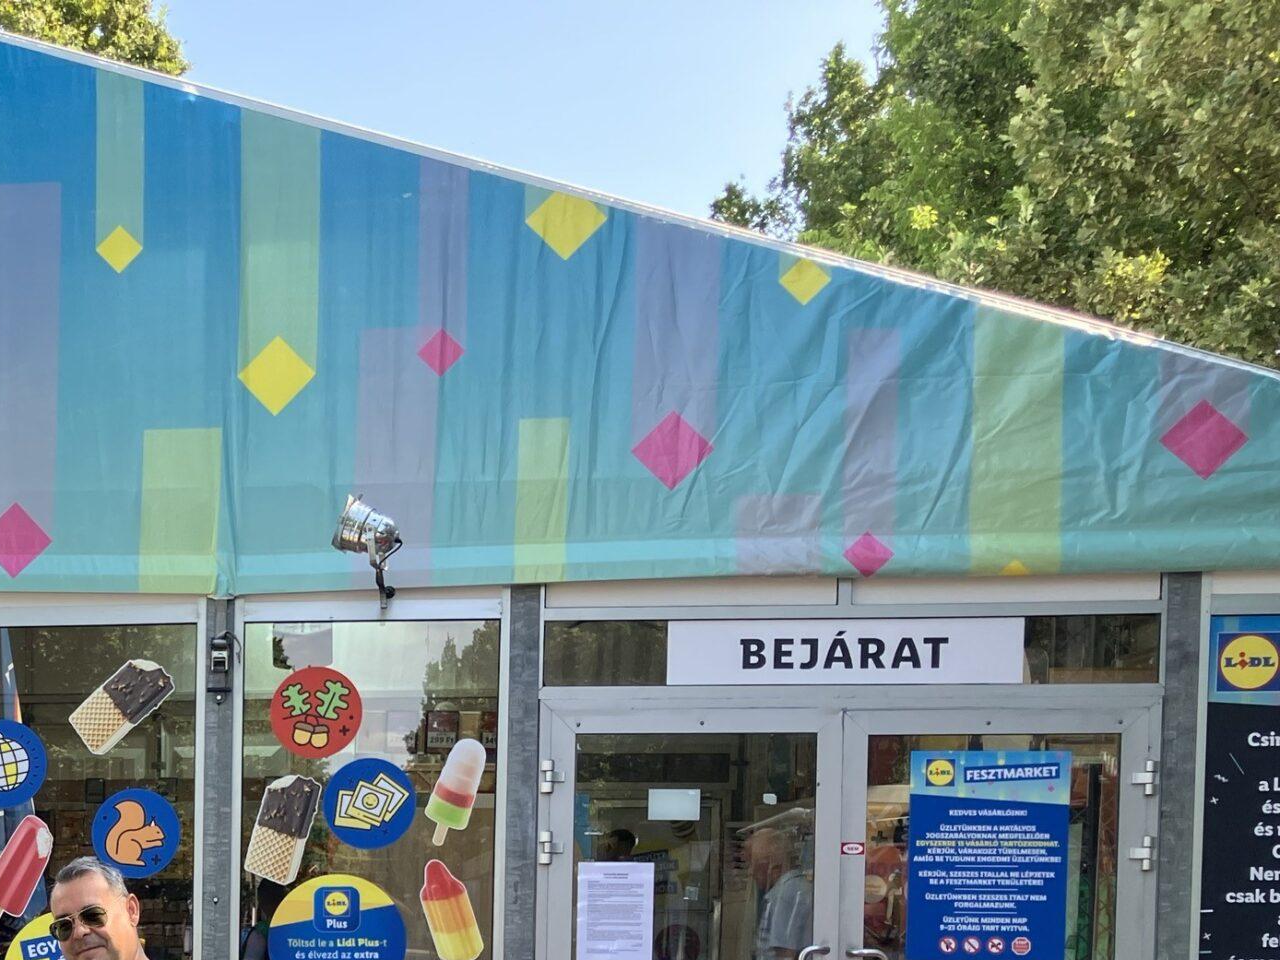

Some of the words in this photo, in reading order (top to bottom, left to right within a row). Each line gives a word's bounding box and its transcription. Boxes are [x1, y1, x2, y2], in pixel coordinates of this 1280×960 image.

[740, 631, 949, 669] BEJÁRAT
[966, 766, 1058, 781] FESZTMARKET
[1258, 780, 1270, 792] a
[1261, 799, 1280, 814] és
[1254, 822, 1274, 836] és
[1225, 888, 1266, 903] csak
[326, 919, 348, 929] Plus
[27, 939, 61, 958] EGY
[287, 938, 315, 947] Töltsd
[318, 939, 326, 947] le
[336, 939, 356, 947] Lidl
[358, 939, 388, 947] Plus-t
[295, 950, 305, 959] és
[308, 950, 338, 959] élvezd
[353, 951, 379, 959] extra
